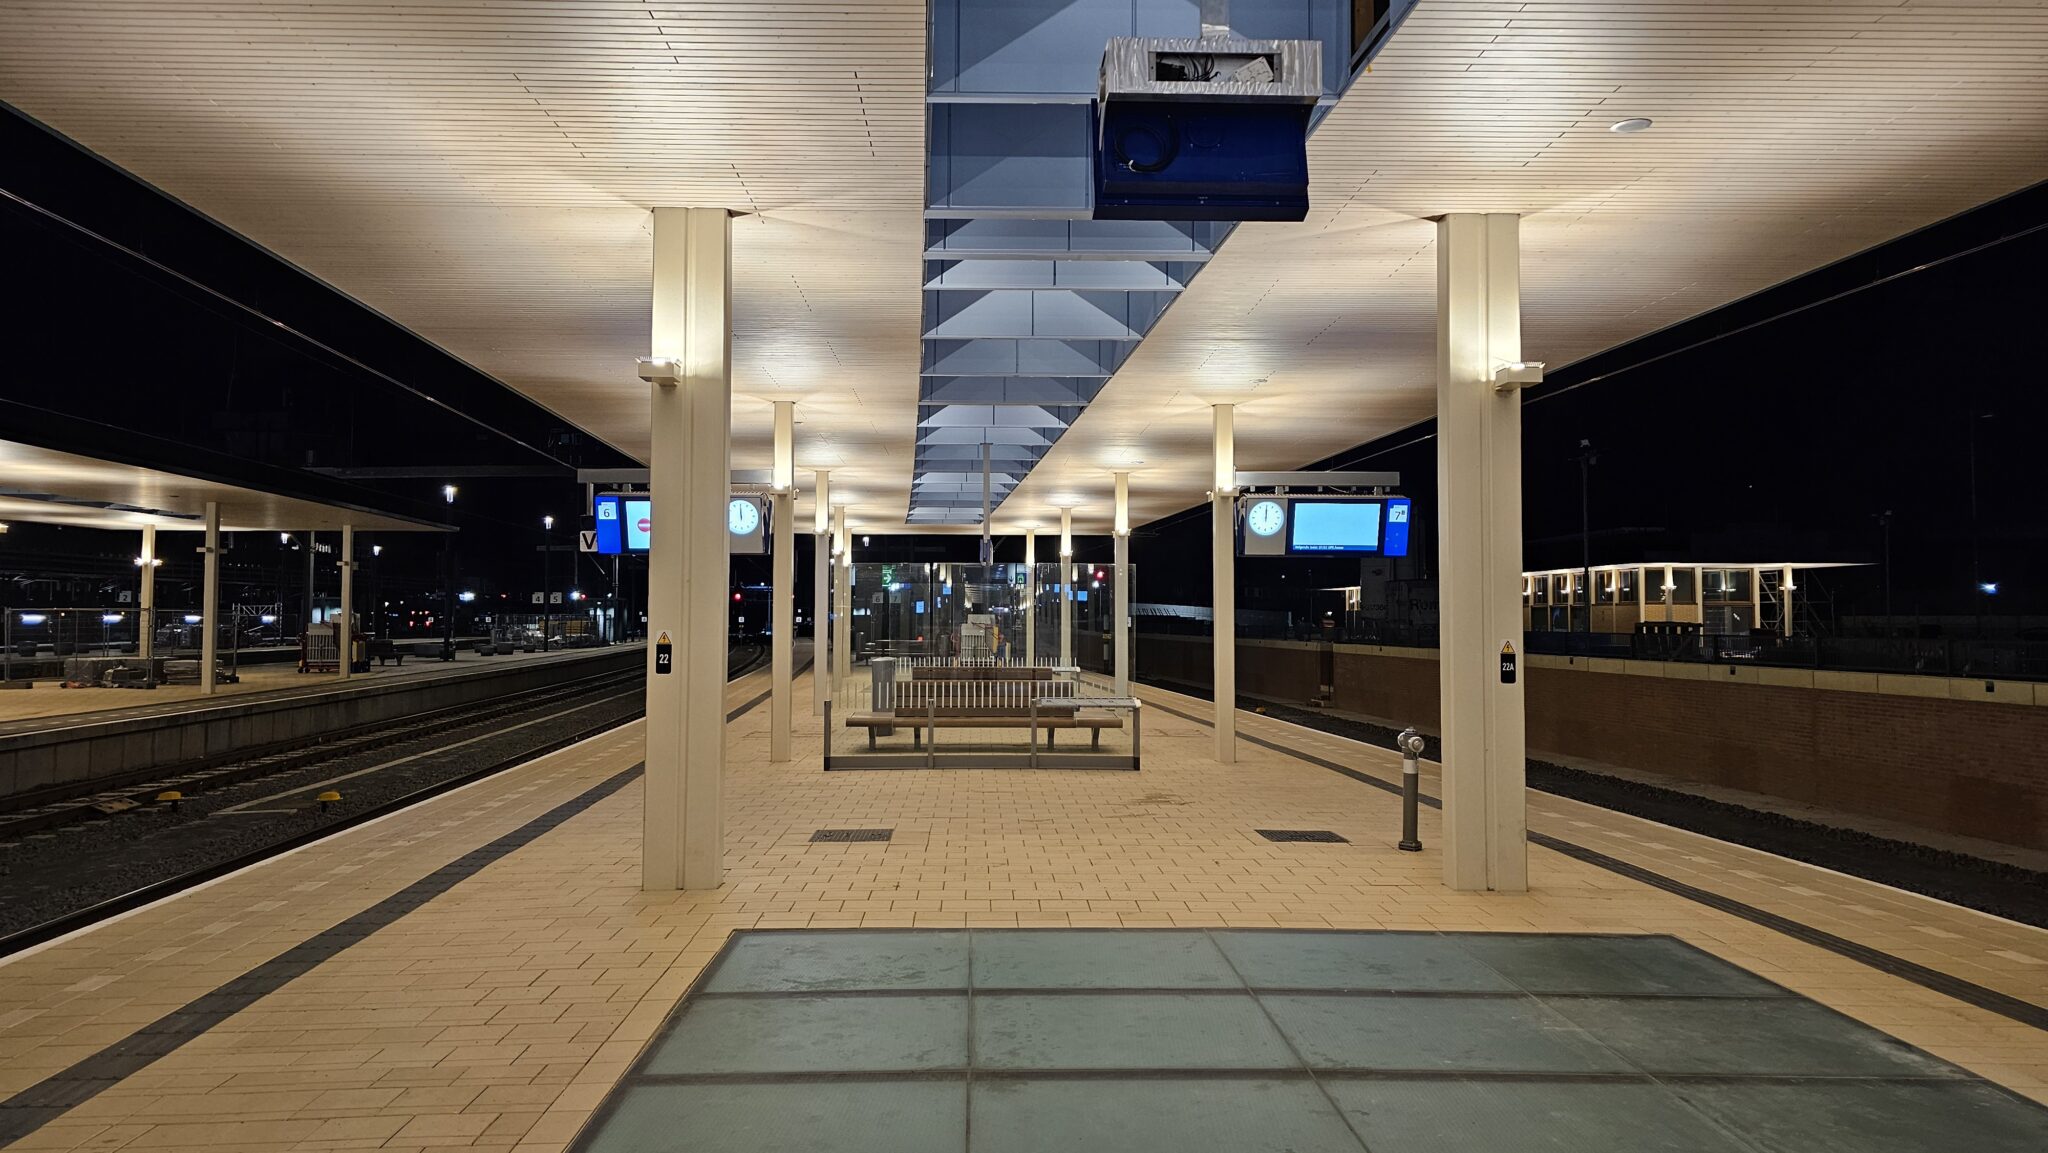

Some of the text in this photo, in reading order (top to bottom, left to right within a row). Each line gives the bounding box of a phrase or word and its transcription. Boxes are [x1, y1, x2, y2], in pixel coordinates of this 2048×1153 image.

[603, 508, 610, 518] 6
[582, 533, 598, 549] V
[122, 594, 128, 602] 2
[659, 653, 669, 664] 22
[1502, 662, 1514, 671] 22A
